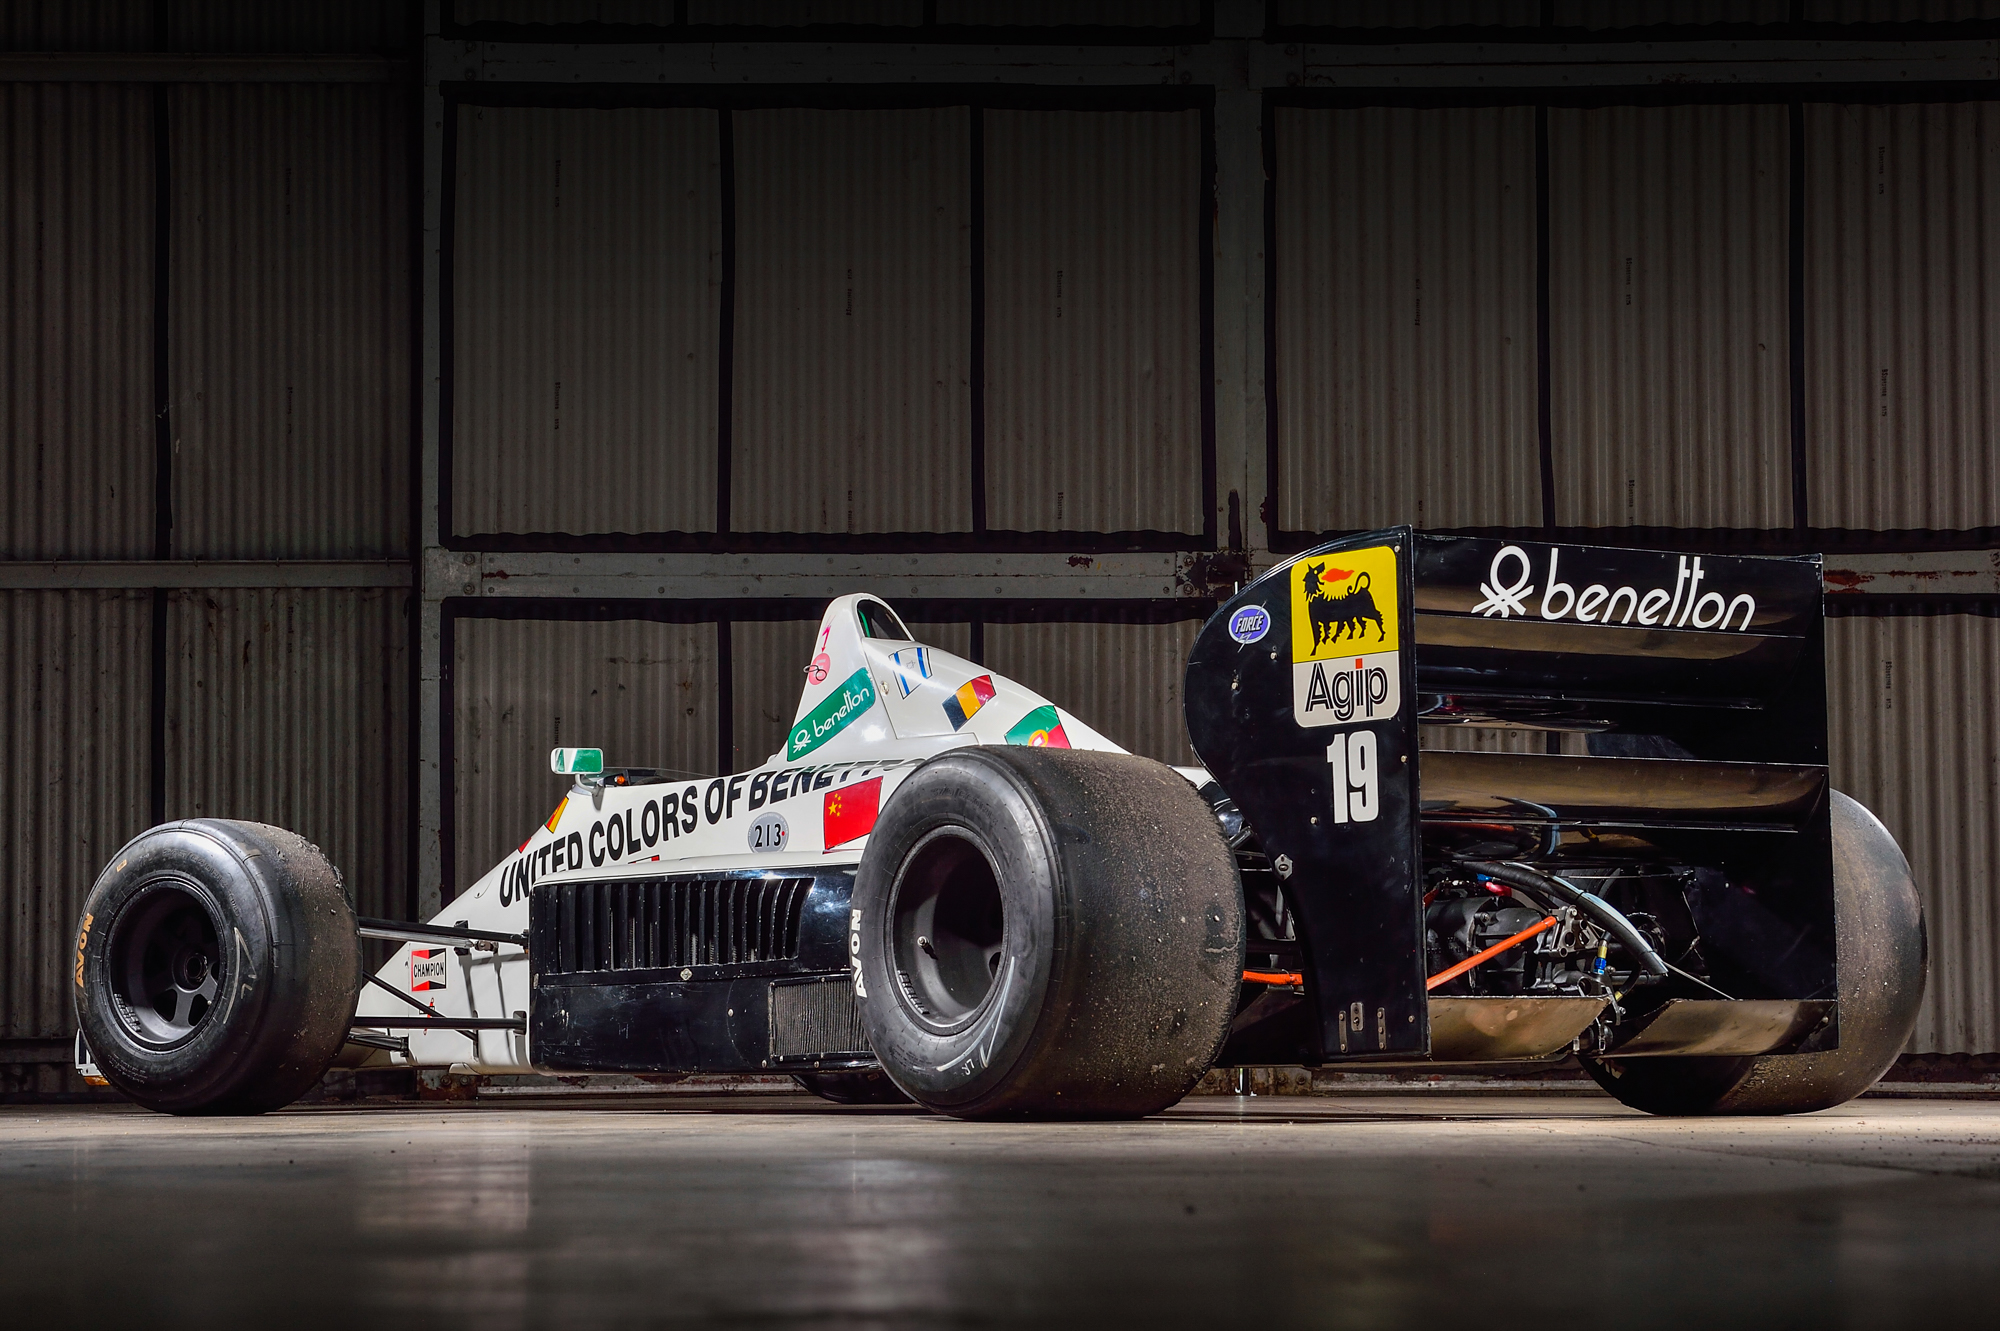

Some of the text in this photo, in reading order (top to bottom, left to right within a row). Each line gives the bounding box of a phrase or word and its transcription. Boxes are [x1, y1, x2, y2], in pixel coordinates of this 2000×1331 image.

[1541, 548, 1755, 631] benetton
[1235, 615, 1265, 634] FORCE
[813, 688, 870, 738] benetton
[1305, 658, 1388, 721] Agip
[1327, 730, 1379, 824] 19
[500, 831, 583, 907] UNITED
[589, 785, 698, 868] COLORS
[704, 774, 752, 825] OF
[754, 823, 782, 848] 213
[76, 913, 94, 988] AVON
[413, 961, 445, 978] CHAMPION
[851, 909, 868, 998] AVON
